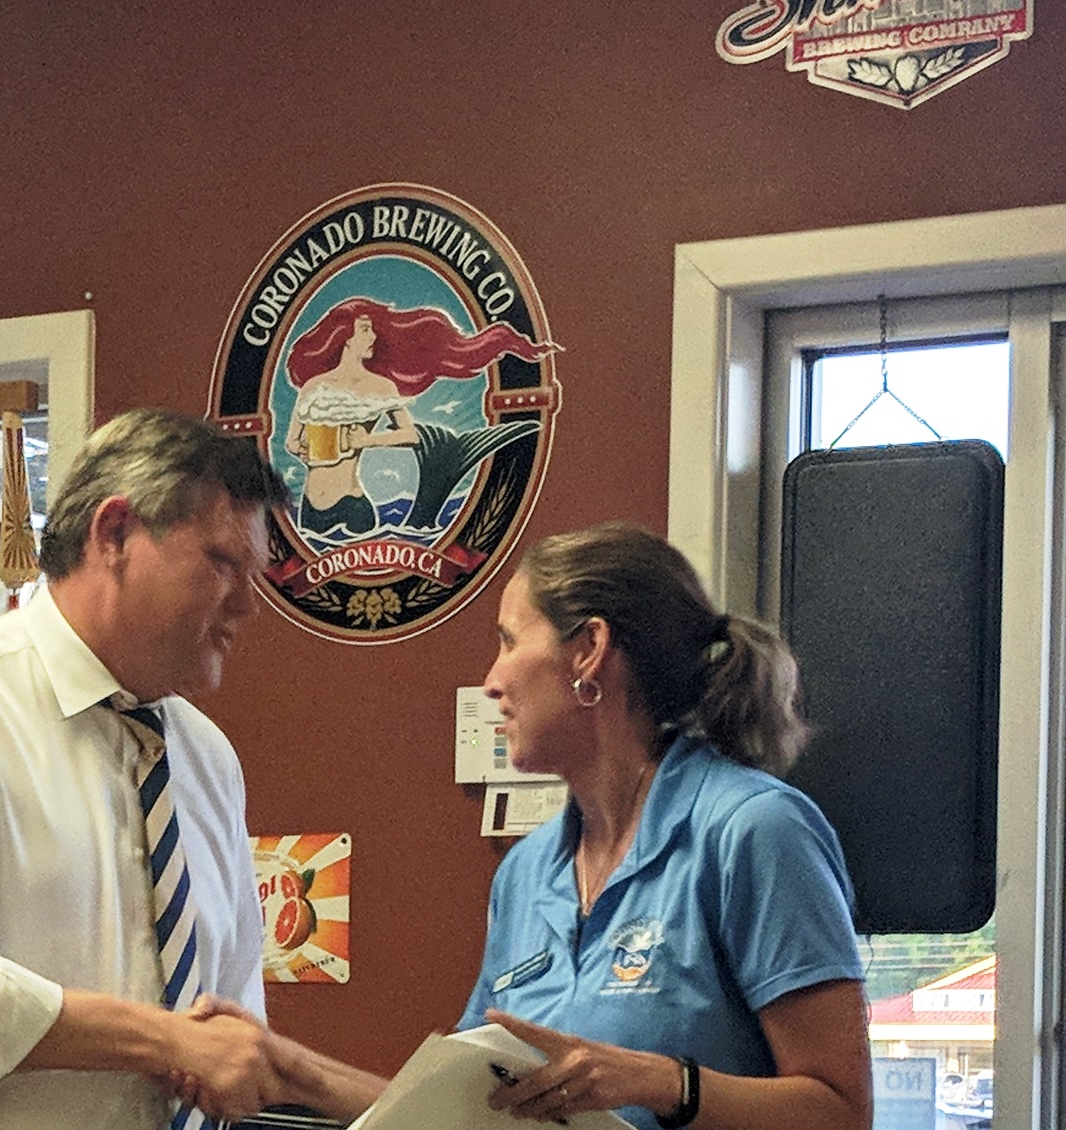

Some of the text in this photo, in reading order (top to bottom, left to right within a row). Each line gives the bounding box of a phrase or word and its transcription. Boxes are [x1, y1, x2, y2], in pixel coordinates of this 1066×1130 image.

[803, 30, 902, 57] BREWING
[908, 15, 1015, 44] COMPANY
[243, 205, 515, 347] CORONADO BREWING CO.
[418, 551, 443, 578] CA
